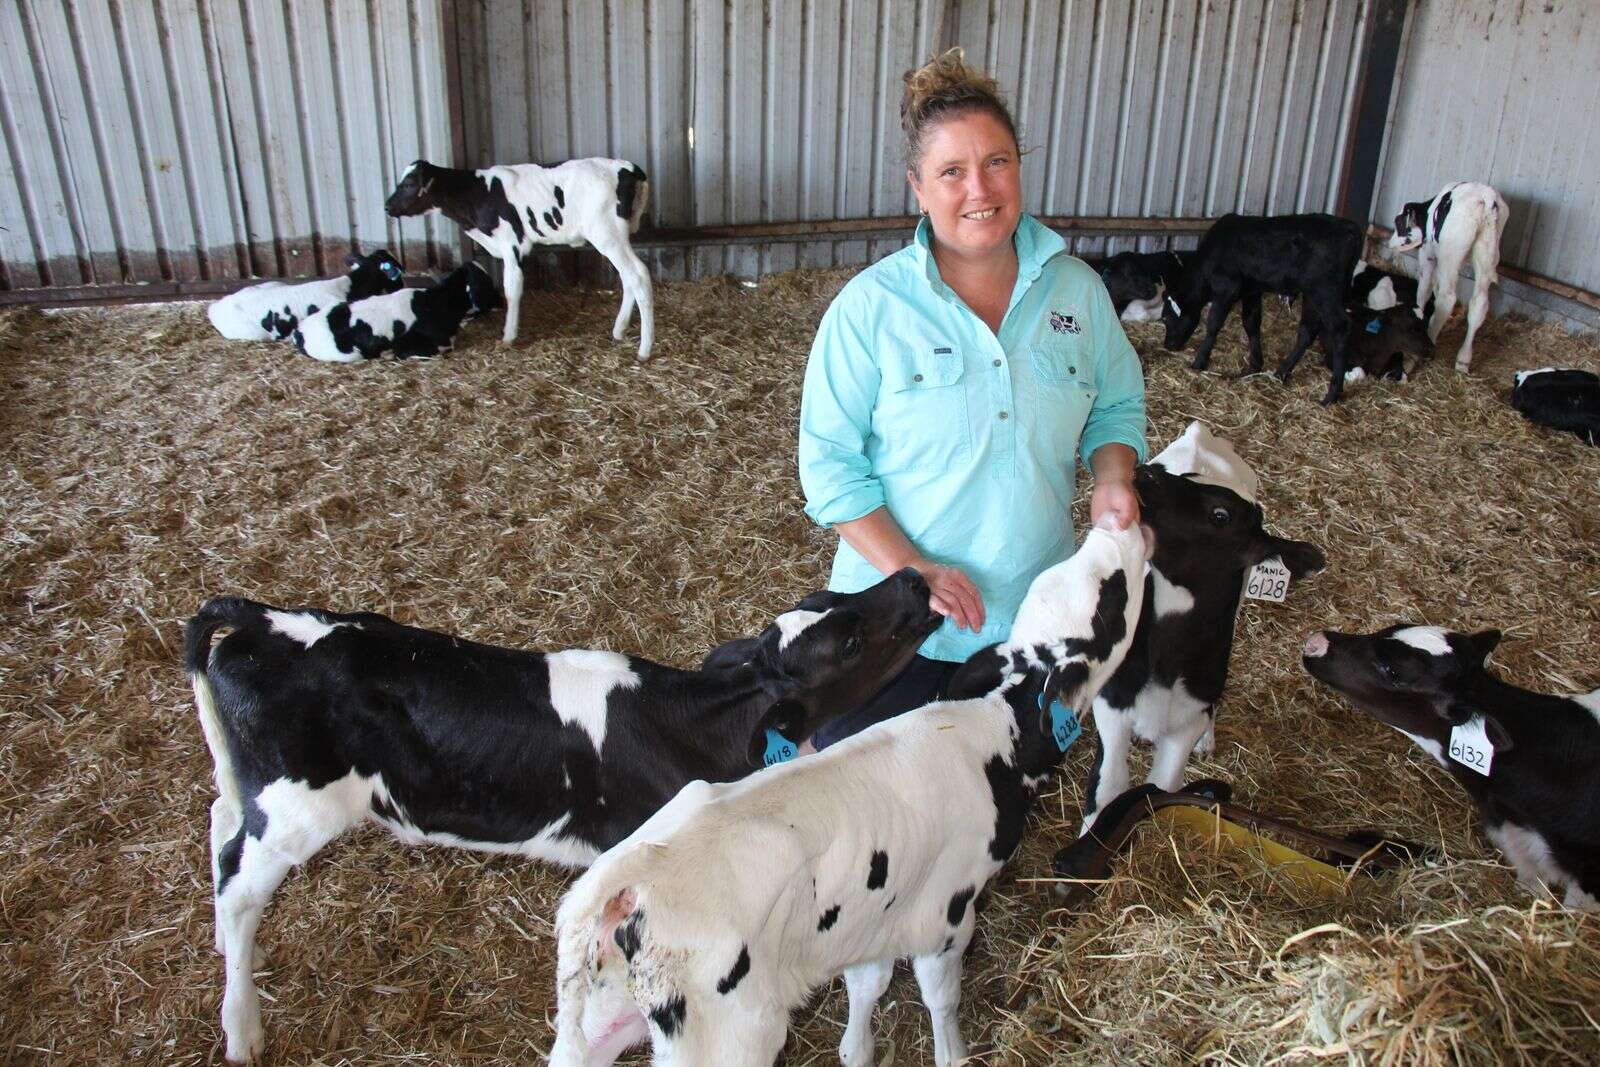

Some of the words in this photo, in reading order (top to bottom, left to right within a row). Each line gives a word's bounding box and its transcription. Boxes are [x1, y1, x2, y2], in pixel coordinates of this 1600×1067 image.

[1256, 566, 1286, 576] MANIC
[1248, 576, 1285, 598] 6128
[766, 745, 792, 766] 4118
[1451, 739, 1485, 768] 6132
